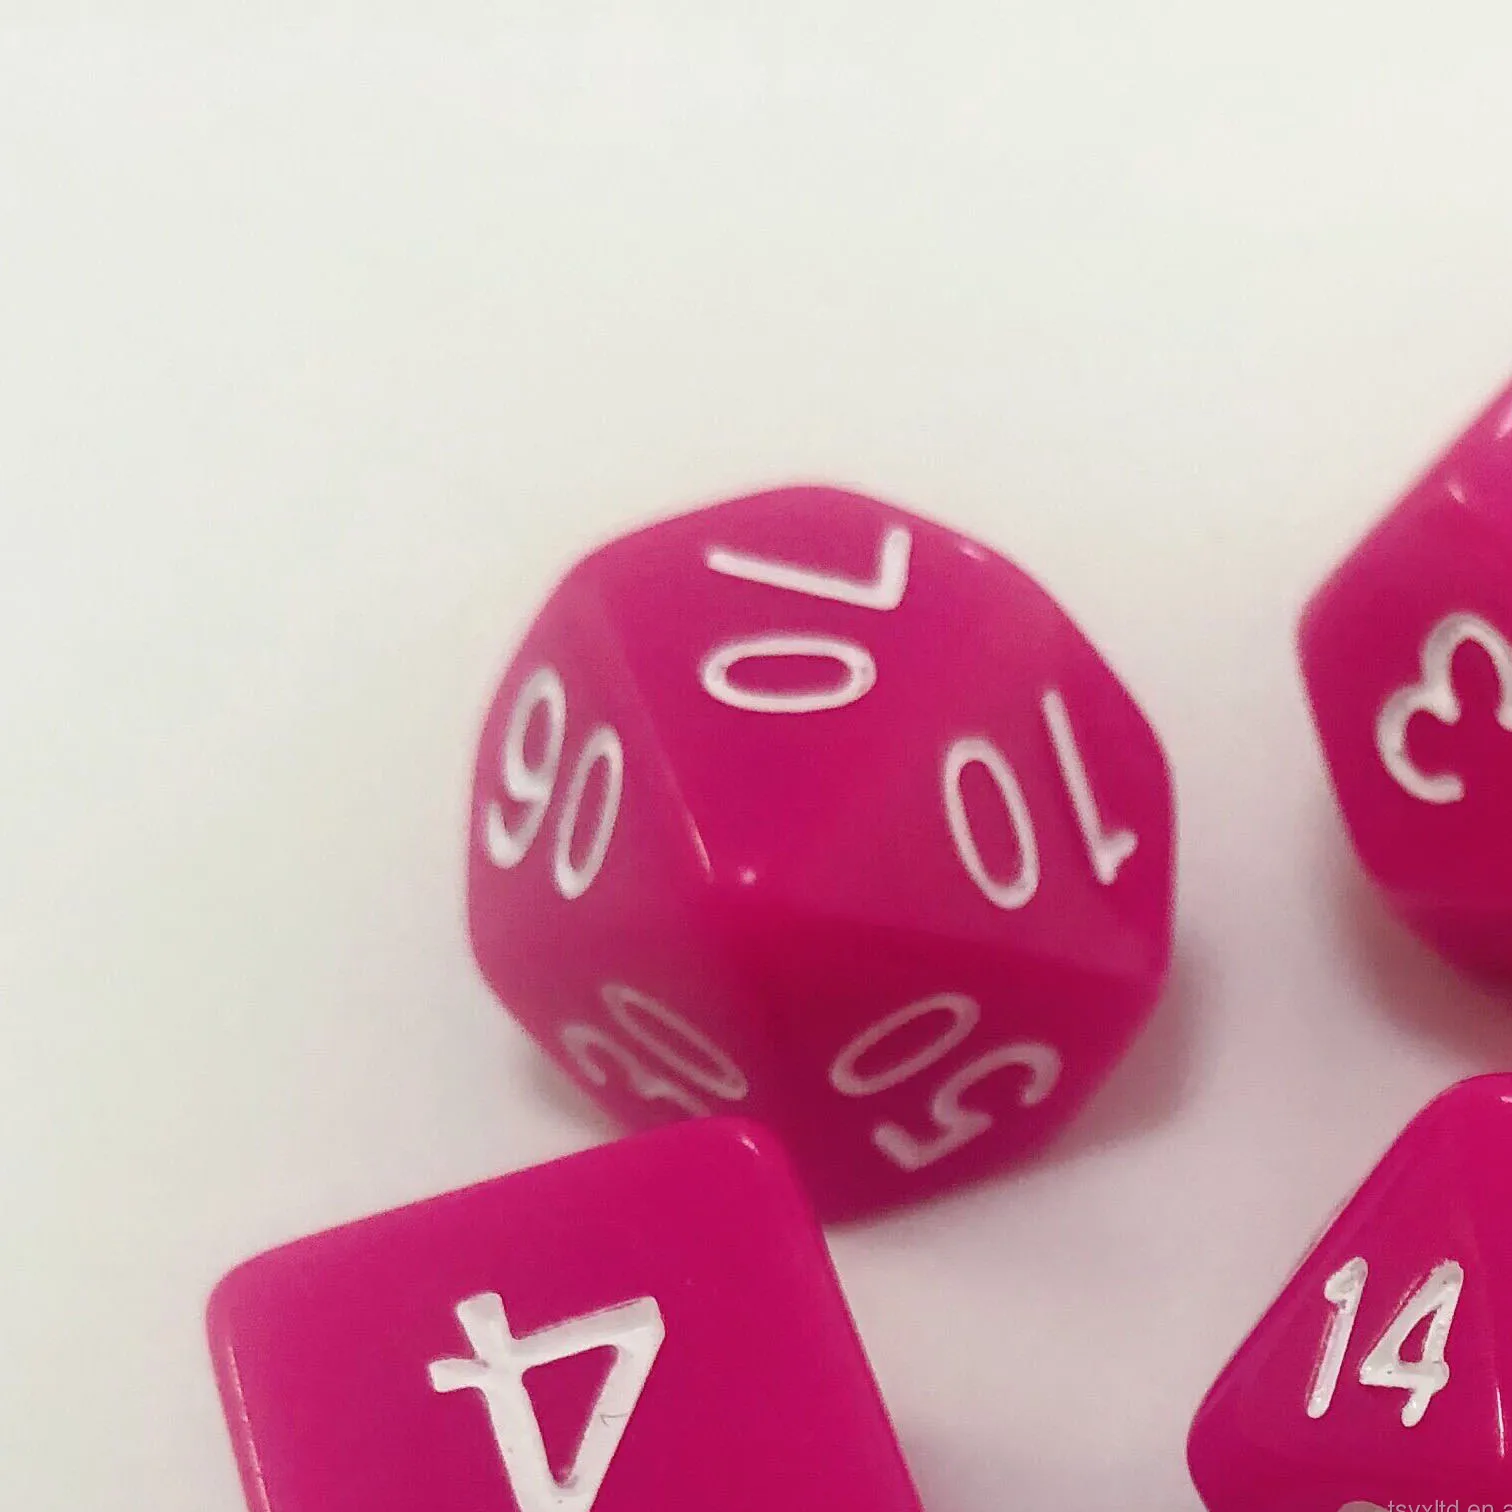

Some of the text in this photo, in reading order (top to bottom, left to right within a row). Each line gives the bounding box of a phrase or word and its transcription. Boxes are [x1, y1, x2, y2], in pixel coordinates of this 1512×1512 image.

[703, 523, 912, 713] 70
[484, 667, 624, 899] 90
[941, 689, 1138, 909] 10
[829, 992, 1062, 1171] 50
[1307, 1256, 1464, 1427] 14
